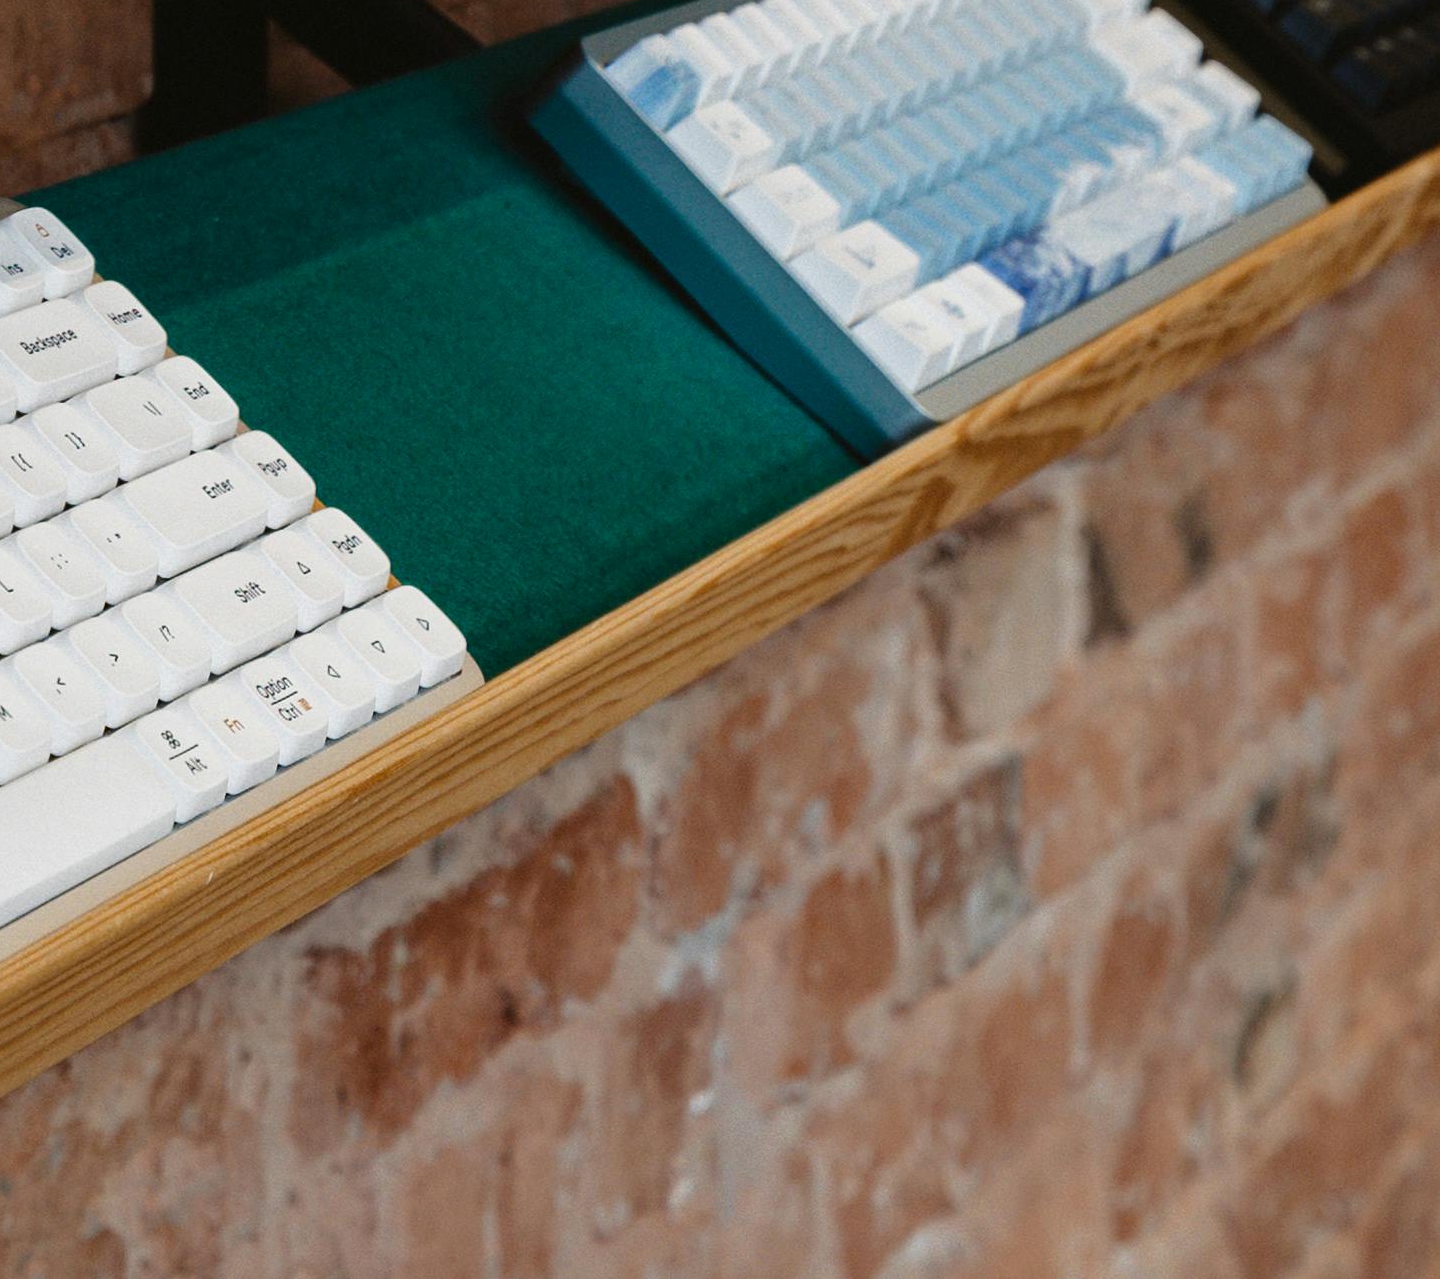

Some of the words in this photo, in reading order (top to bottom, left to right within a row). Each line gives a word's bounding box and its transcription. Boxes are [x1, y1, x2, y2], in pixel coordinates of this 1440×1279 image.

[50, 246, 72, 259] Del
[4, 263, 25, 275] Ins
[107, 308, 143, 325] Home
[19, 329, 78, 355] Backspace
[182, 382, 210, 401] End
[256, 458, 288, 478] Pgup
[201, 478, 233, 500] Enter
[331, 535, 362, 555] Pgdn
[233, 581, 266, 604] Shift
[255, 676, 297, 703] Option
[278, 702, 299, 723] Ctrl
[223, 718, 244, 733] Fn
[185, 758, 208, 773] Alt
